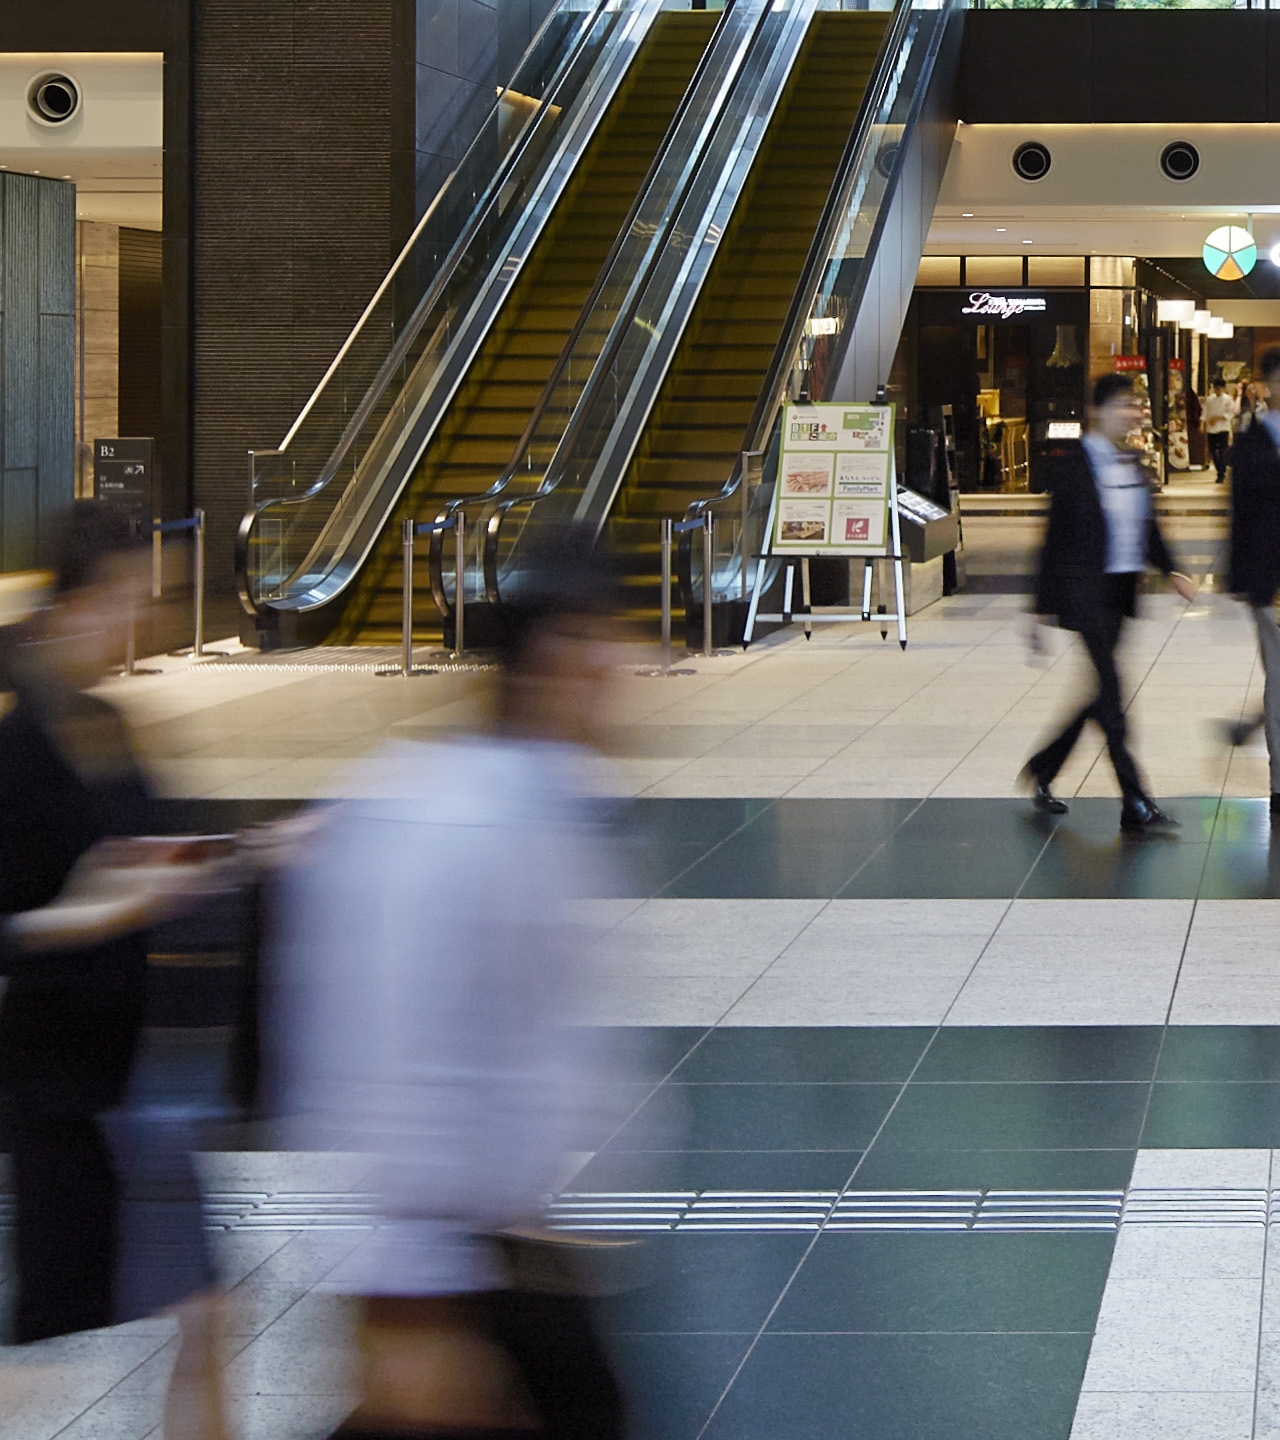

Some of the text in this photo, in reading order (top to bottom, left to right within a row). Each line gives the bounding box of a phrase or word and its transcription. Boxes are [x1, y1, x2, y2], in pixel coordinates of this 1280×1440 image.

[962, 293, 1024, 319] Lounge
[792, 423, 819, 432] B1F
[101, 445, 115, 457] B2
